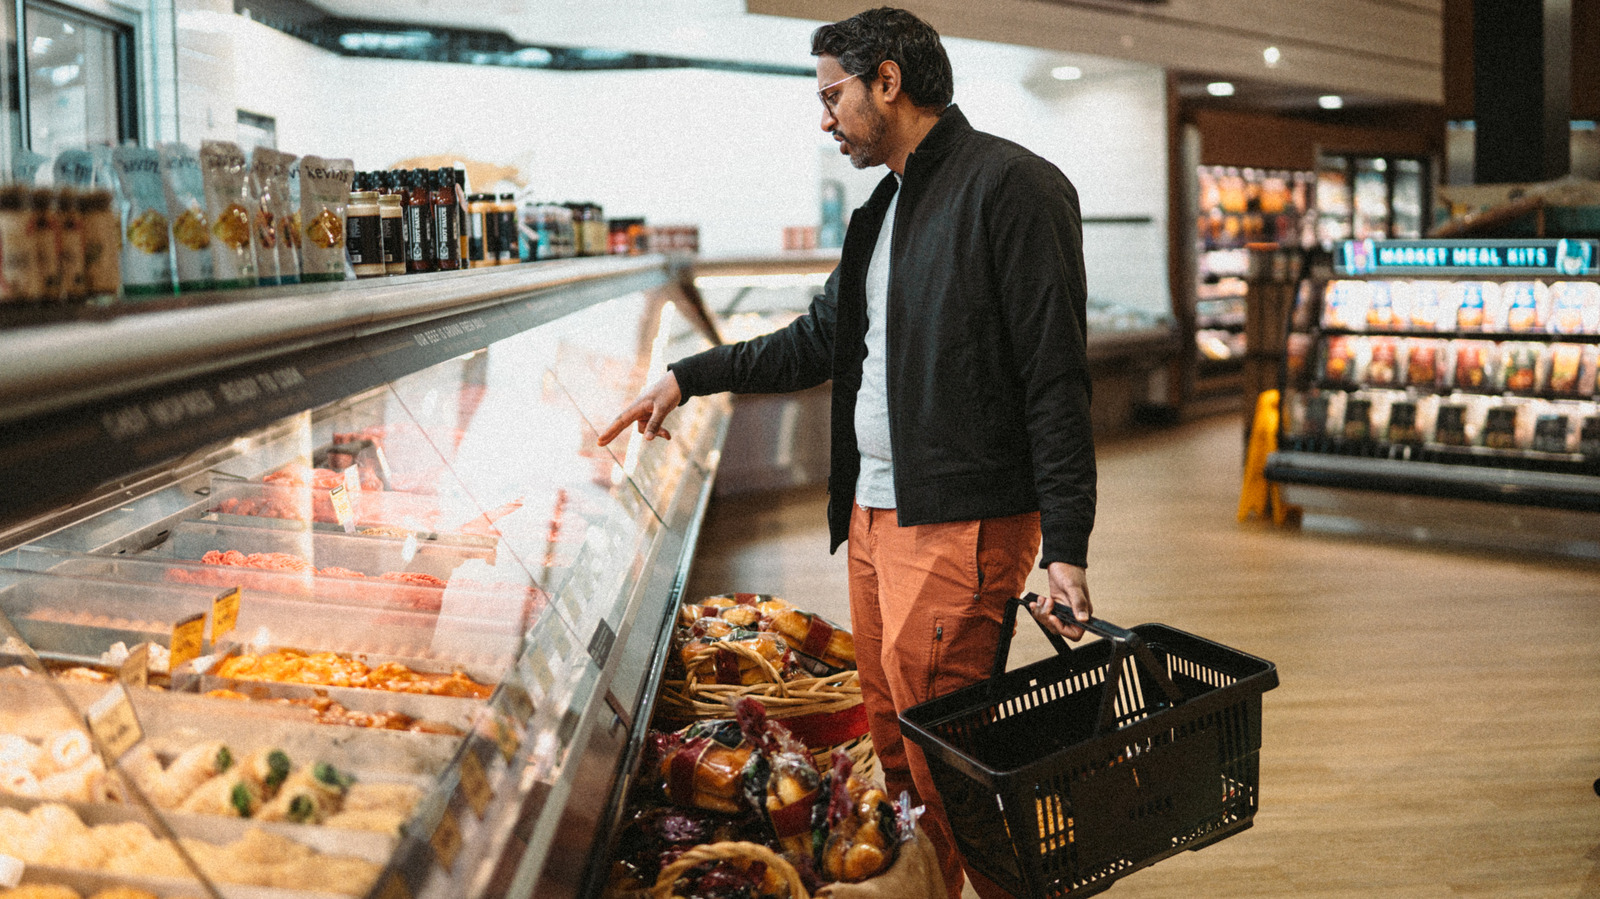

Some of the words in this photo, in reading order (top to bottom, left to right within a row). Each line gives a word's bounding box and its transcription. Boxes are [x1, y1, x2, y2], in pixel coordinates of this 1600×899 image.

[305, 165, 349, 183] kevins
[1379, 247, 1448, 266] MARKET
[1453, 247, 1502, 266] MEAL
[1507, 247, 1548, 266] KITS
